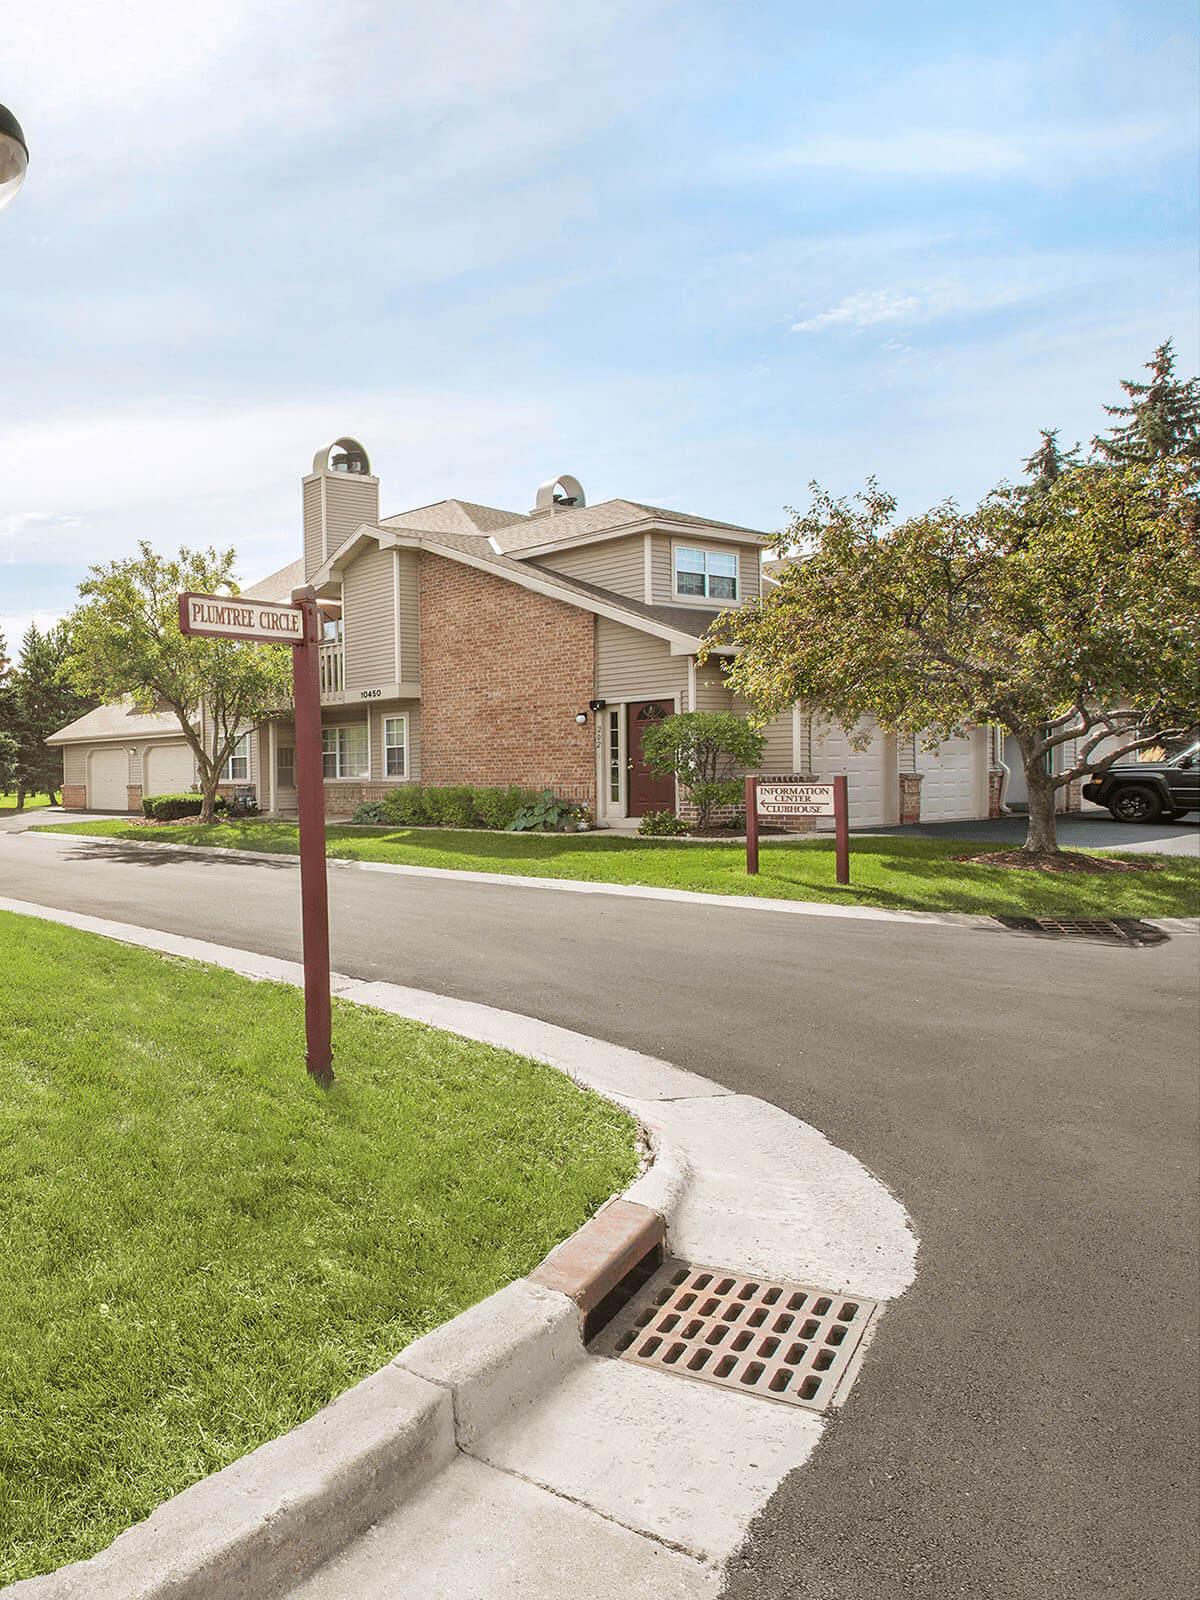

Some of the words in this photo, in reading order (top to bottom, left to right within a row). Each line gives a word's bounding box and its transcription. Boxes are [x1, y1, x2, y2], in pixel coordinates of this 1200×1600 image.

[191, 603, 255, 628] PLUMTREE
[259, 612, 299, 633] CIRCLE
[360, 689, 382, 698] 10450
[760, 787, 829, 795] INFORMATION
[766, 805, 822, 814] CLUBHOUSE
